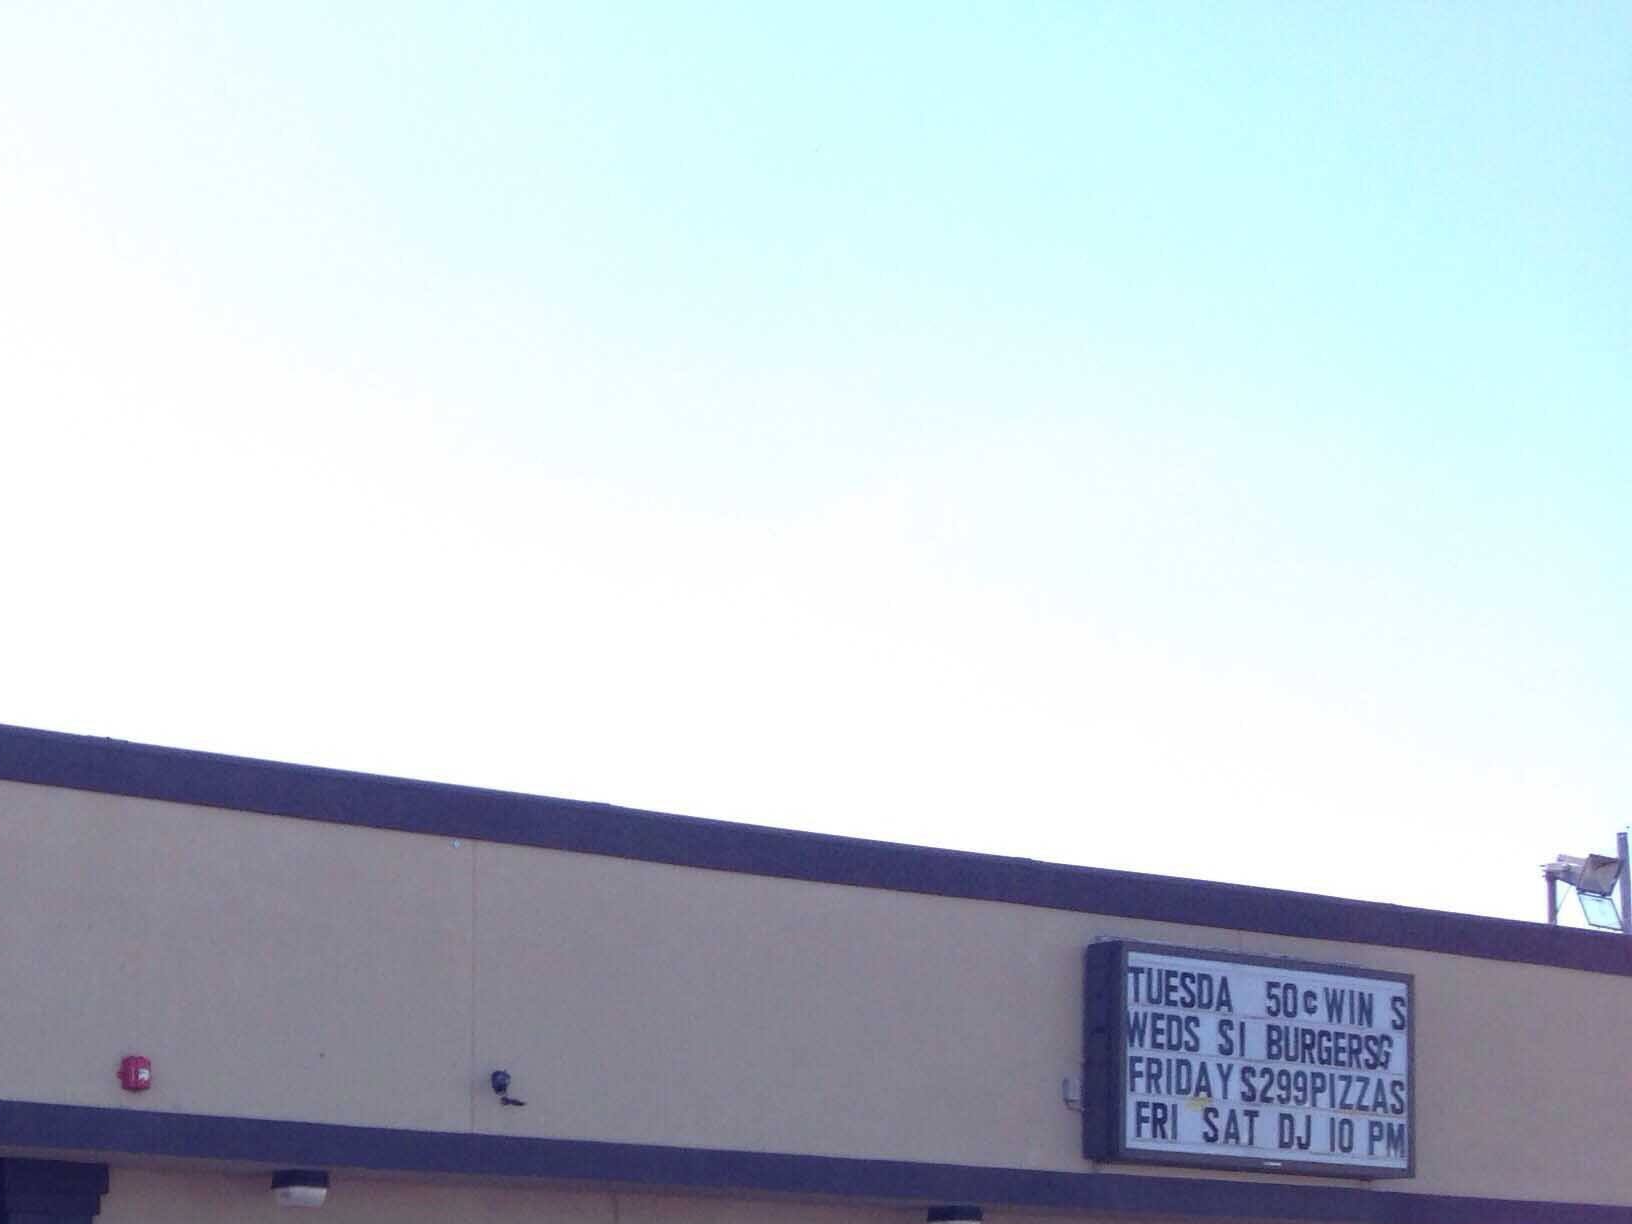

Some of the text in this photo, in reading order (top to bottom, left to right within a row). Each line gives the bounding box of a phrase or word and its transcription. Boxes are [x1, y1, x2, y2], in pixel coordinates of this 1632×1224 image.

[1128, 966, 1233, 1013] TUESDA
[1127, 1011, 1200, 1053] WEDS
[1129, 1056, 1234, 1100] FRIDAY
[1136, 1101, 1405, 1158] FRI SAT DJ 10 PM
